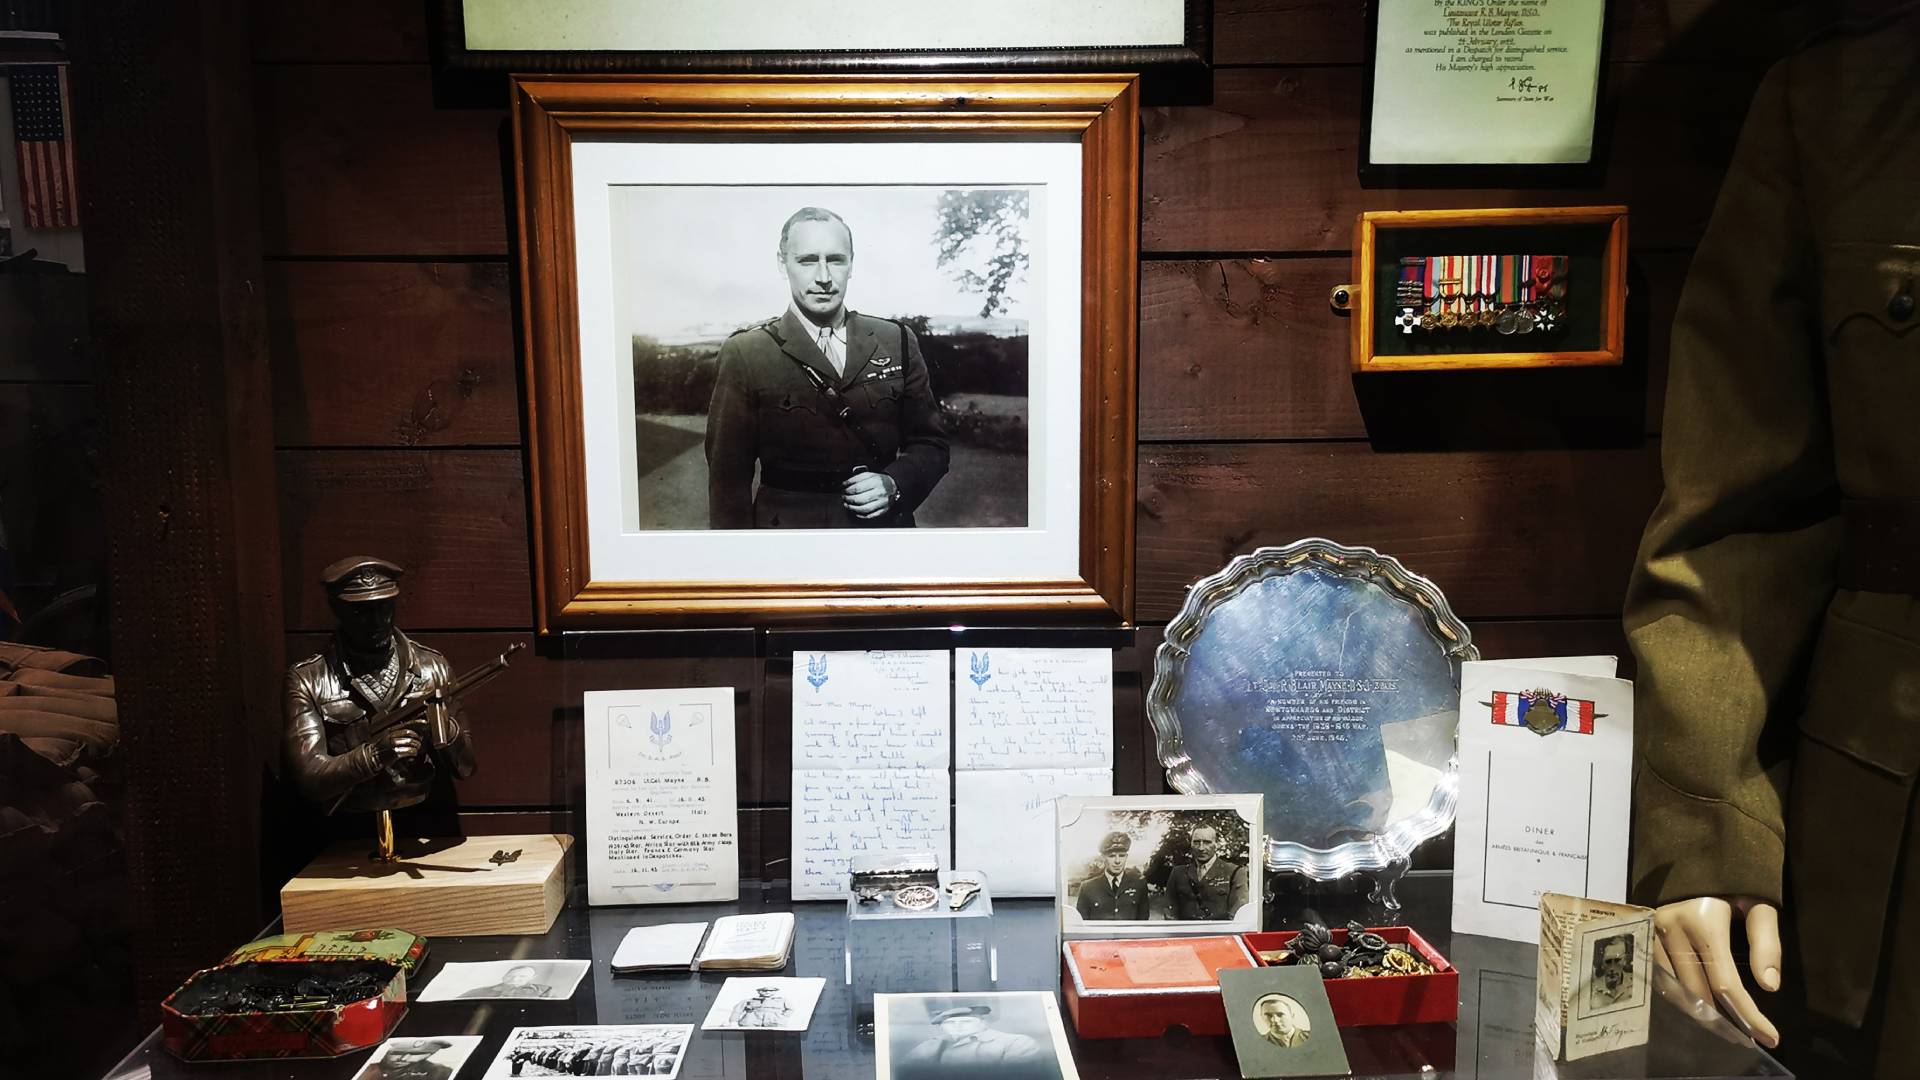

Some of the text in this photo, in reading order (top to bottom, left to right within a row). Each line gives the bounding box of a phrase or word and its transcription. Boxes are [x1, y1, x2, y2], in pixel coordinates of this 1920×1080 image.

[1438, 27, 1468, 37] published
[1414, 45, 1446, 54] mentioned
[1525, 826, 1554, 836] DINER
